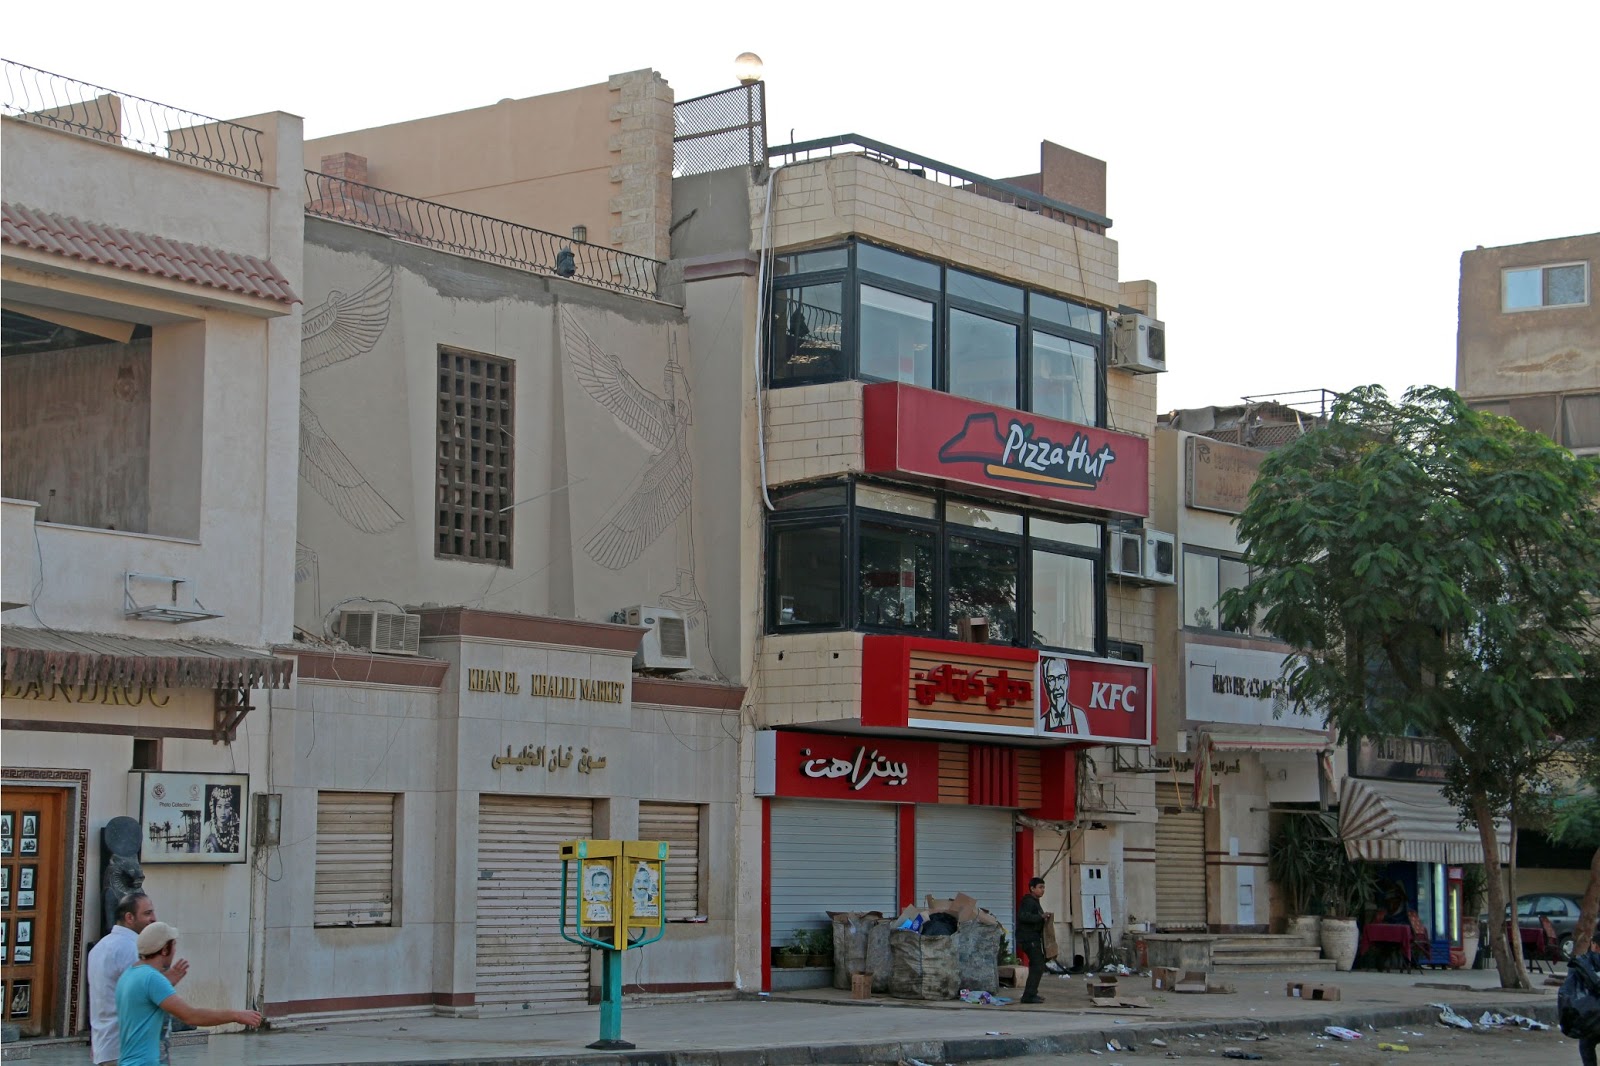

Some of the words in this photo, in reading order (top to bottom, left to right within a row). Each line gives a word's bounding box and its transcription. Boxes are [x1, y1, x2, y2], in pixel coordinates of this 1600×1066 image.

[1002, 423, 1064, 472] Pizza
[1066, 435, 1115, 478] Hut
[468, 668, 501, 693] KHAN
[504, 672, 520, 695] EL
[531, 674, 577, 700] KHALILI
[579, 679, 625, 704] MARKET
[986, 670, 1032, 711] دجاج
[1088, 681, 1138, 713] KFC
[549, 745, 574, 773] خان
[578, 747, 606, 774] سوق
[804, 757, 854, 778] هت
[851, 745, 908, 791] بيتزا
